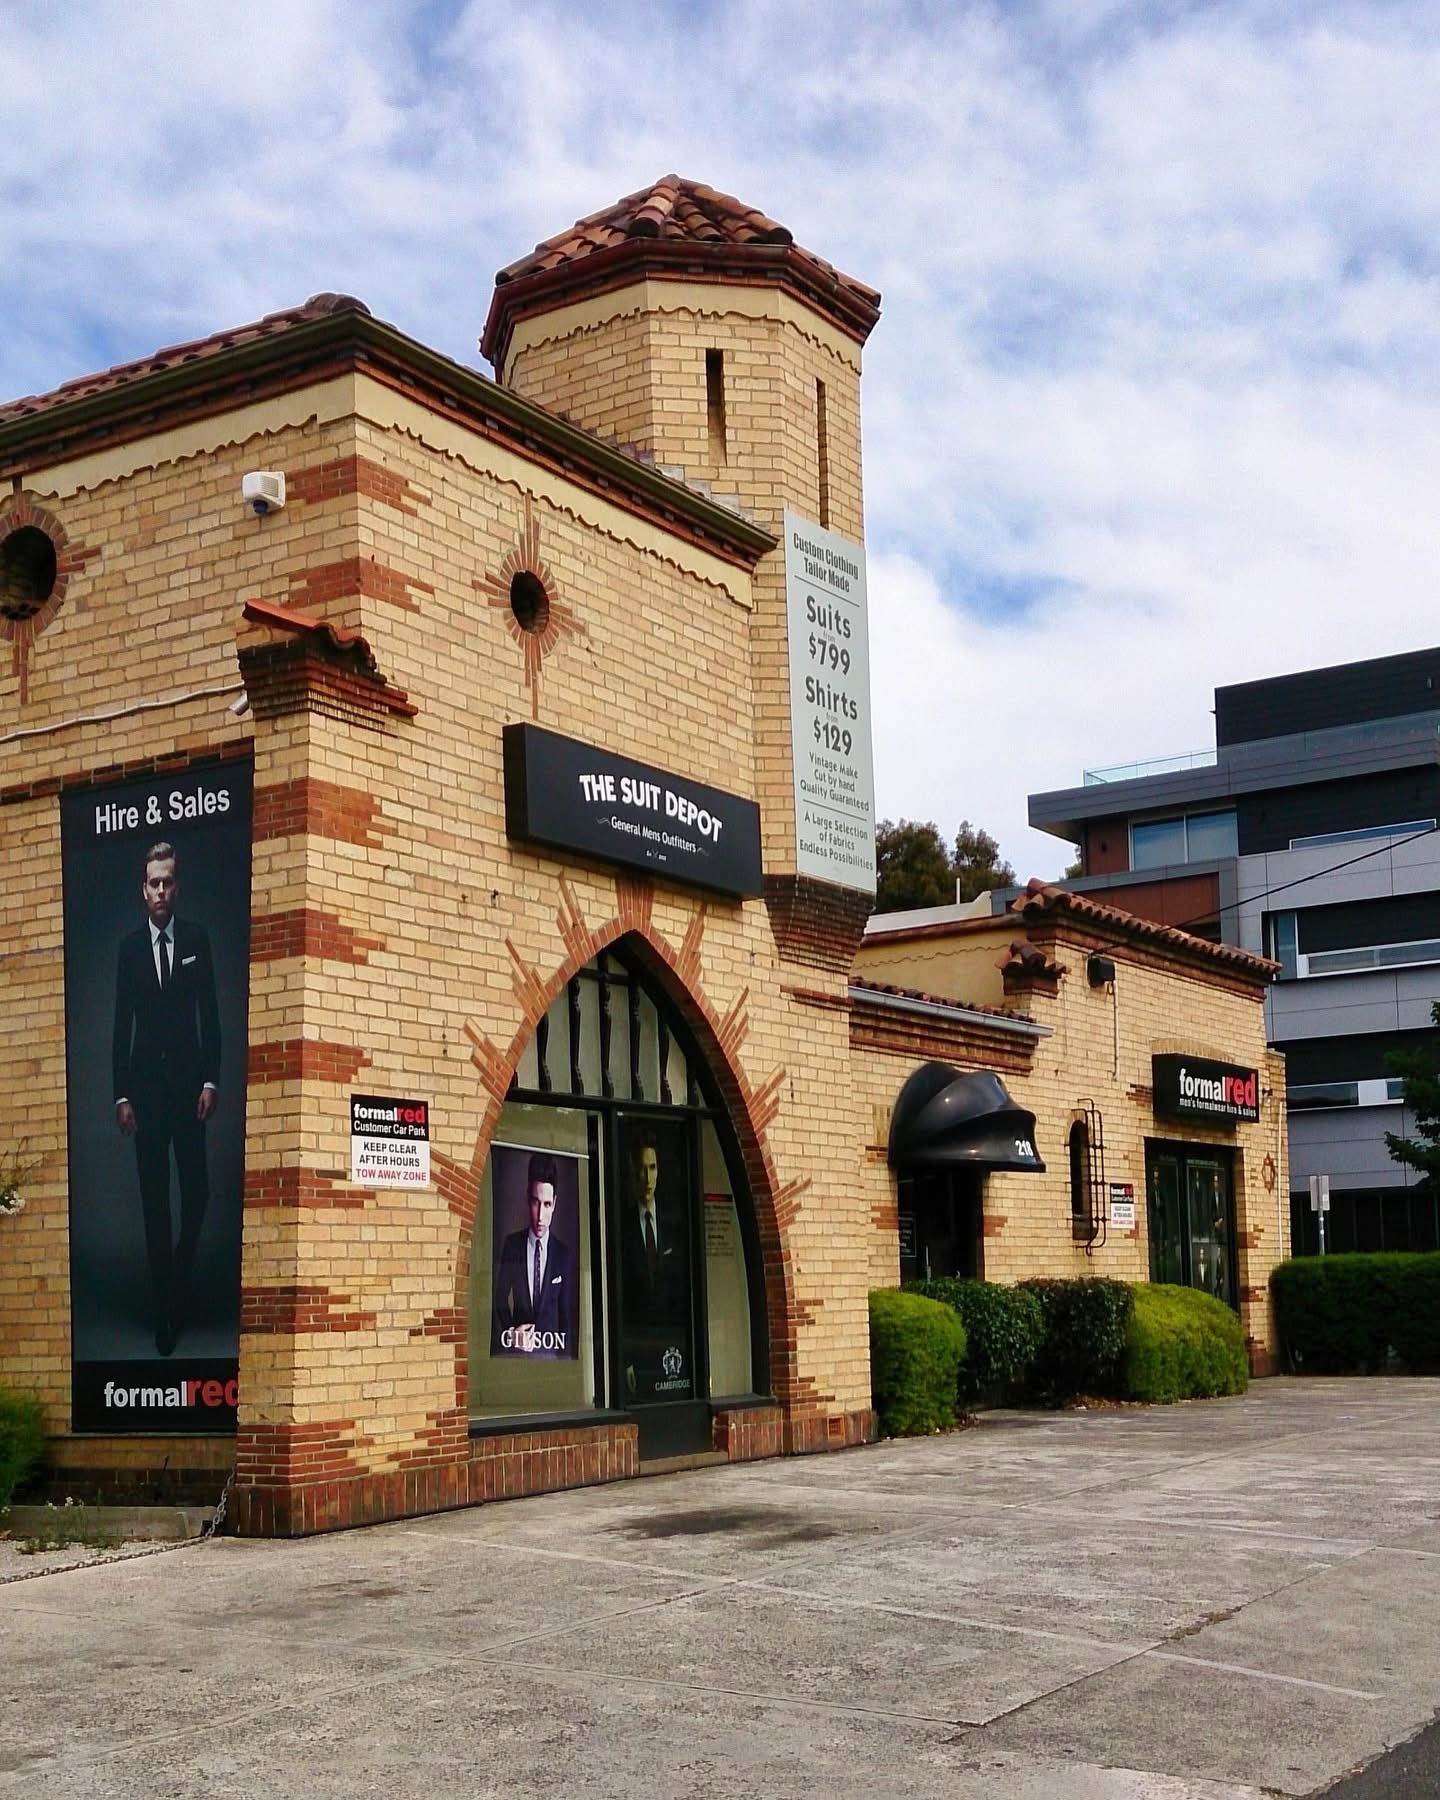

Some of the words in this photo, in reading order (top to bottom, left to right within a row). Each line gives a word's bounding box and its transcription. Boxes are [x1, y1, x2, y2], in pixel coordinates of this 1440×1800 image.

[794, 533, 824, 561] Custom
[826, 549, 858, 580] Clothing
[804, 557, 827, 582] Tailor
[829, 569, 850, 592] Made
[806, 595, 850, 638] Suits
[809, 632, 850, 675] $799
[805, 675, 857, 720] Shirts
[814, 715, 852, 757] $129
[809, 752, 837, 773] Vintage
[839, 763, 858, 779] Make
[814, 768, 826, 783] Cut
[828, 773, 837, 788] by
[839, 777, 855, 792] hand
[95, 804, 139, 834] Hire
[145, 795, 163, 825] &
[168, 786, 231, 821] Sales
[579, 774, 617, 802] THE
[620, 777, 661, 811] SUIT
[665, 789, 723, 843] DEPOT
[800, 779, 827, 800] Quality
[829, 788, 869, 811] Guaranteed
[611, 815, 641, 837] General
[642, 826, 661, 843] Mens
[662, 831, 696, 854] Outfitters
[804, 811, 810, 823] A
[812, 812, 832, 830] Large
[834, 820, 868, 841] Selection
[819, 832, 827, 844] of
[829, 833, 855, 851] Fabrics
[800, 839, 827, 857] Endless
[829, 848, 873, 871] Possibilities
[1179, 1068, 1256, 1107] formalred
[353, 1103, 425, 1124] formalred
[354, 1120, 392, 1134] Customer
[393, 1124, 407, 1135] Car
[408, 1125, 426, 1136] Park
[359, 1154, 388, 1165] AFTER
[389, 1157, 420, 1167] HOURS
[363, 1141, 387, 1152] KEEP
[388, 1144, 417, 1155] CLEAR
[356, 1168, 376, 1179] TOW
[377, 1169, 401, 1180] AWAY
[403, 1171, 427, 1181] ZONE
